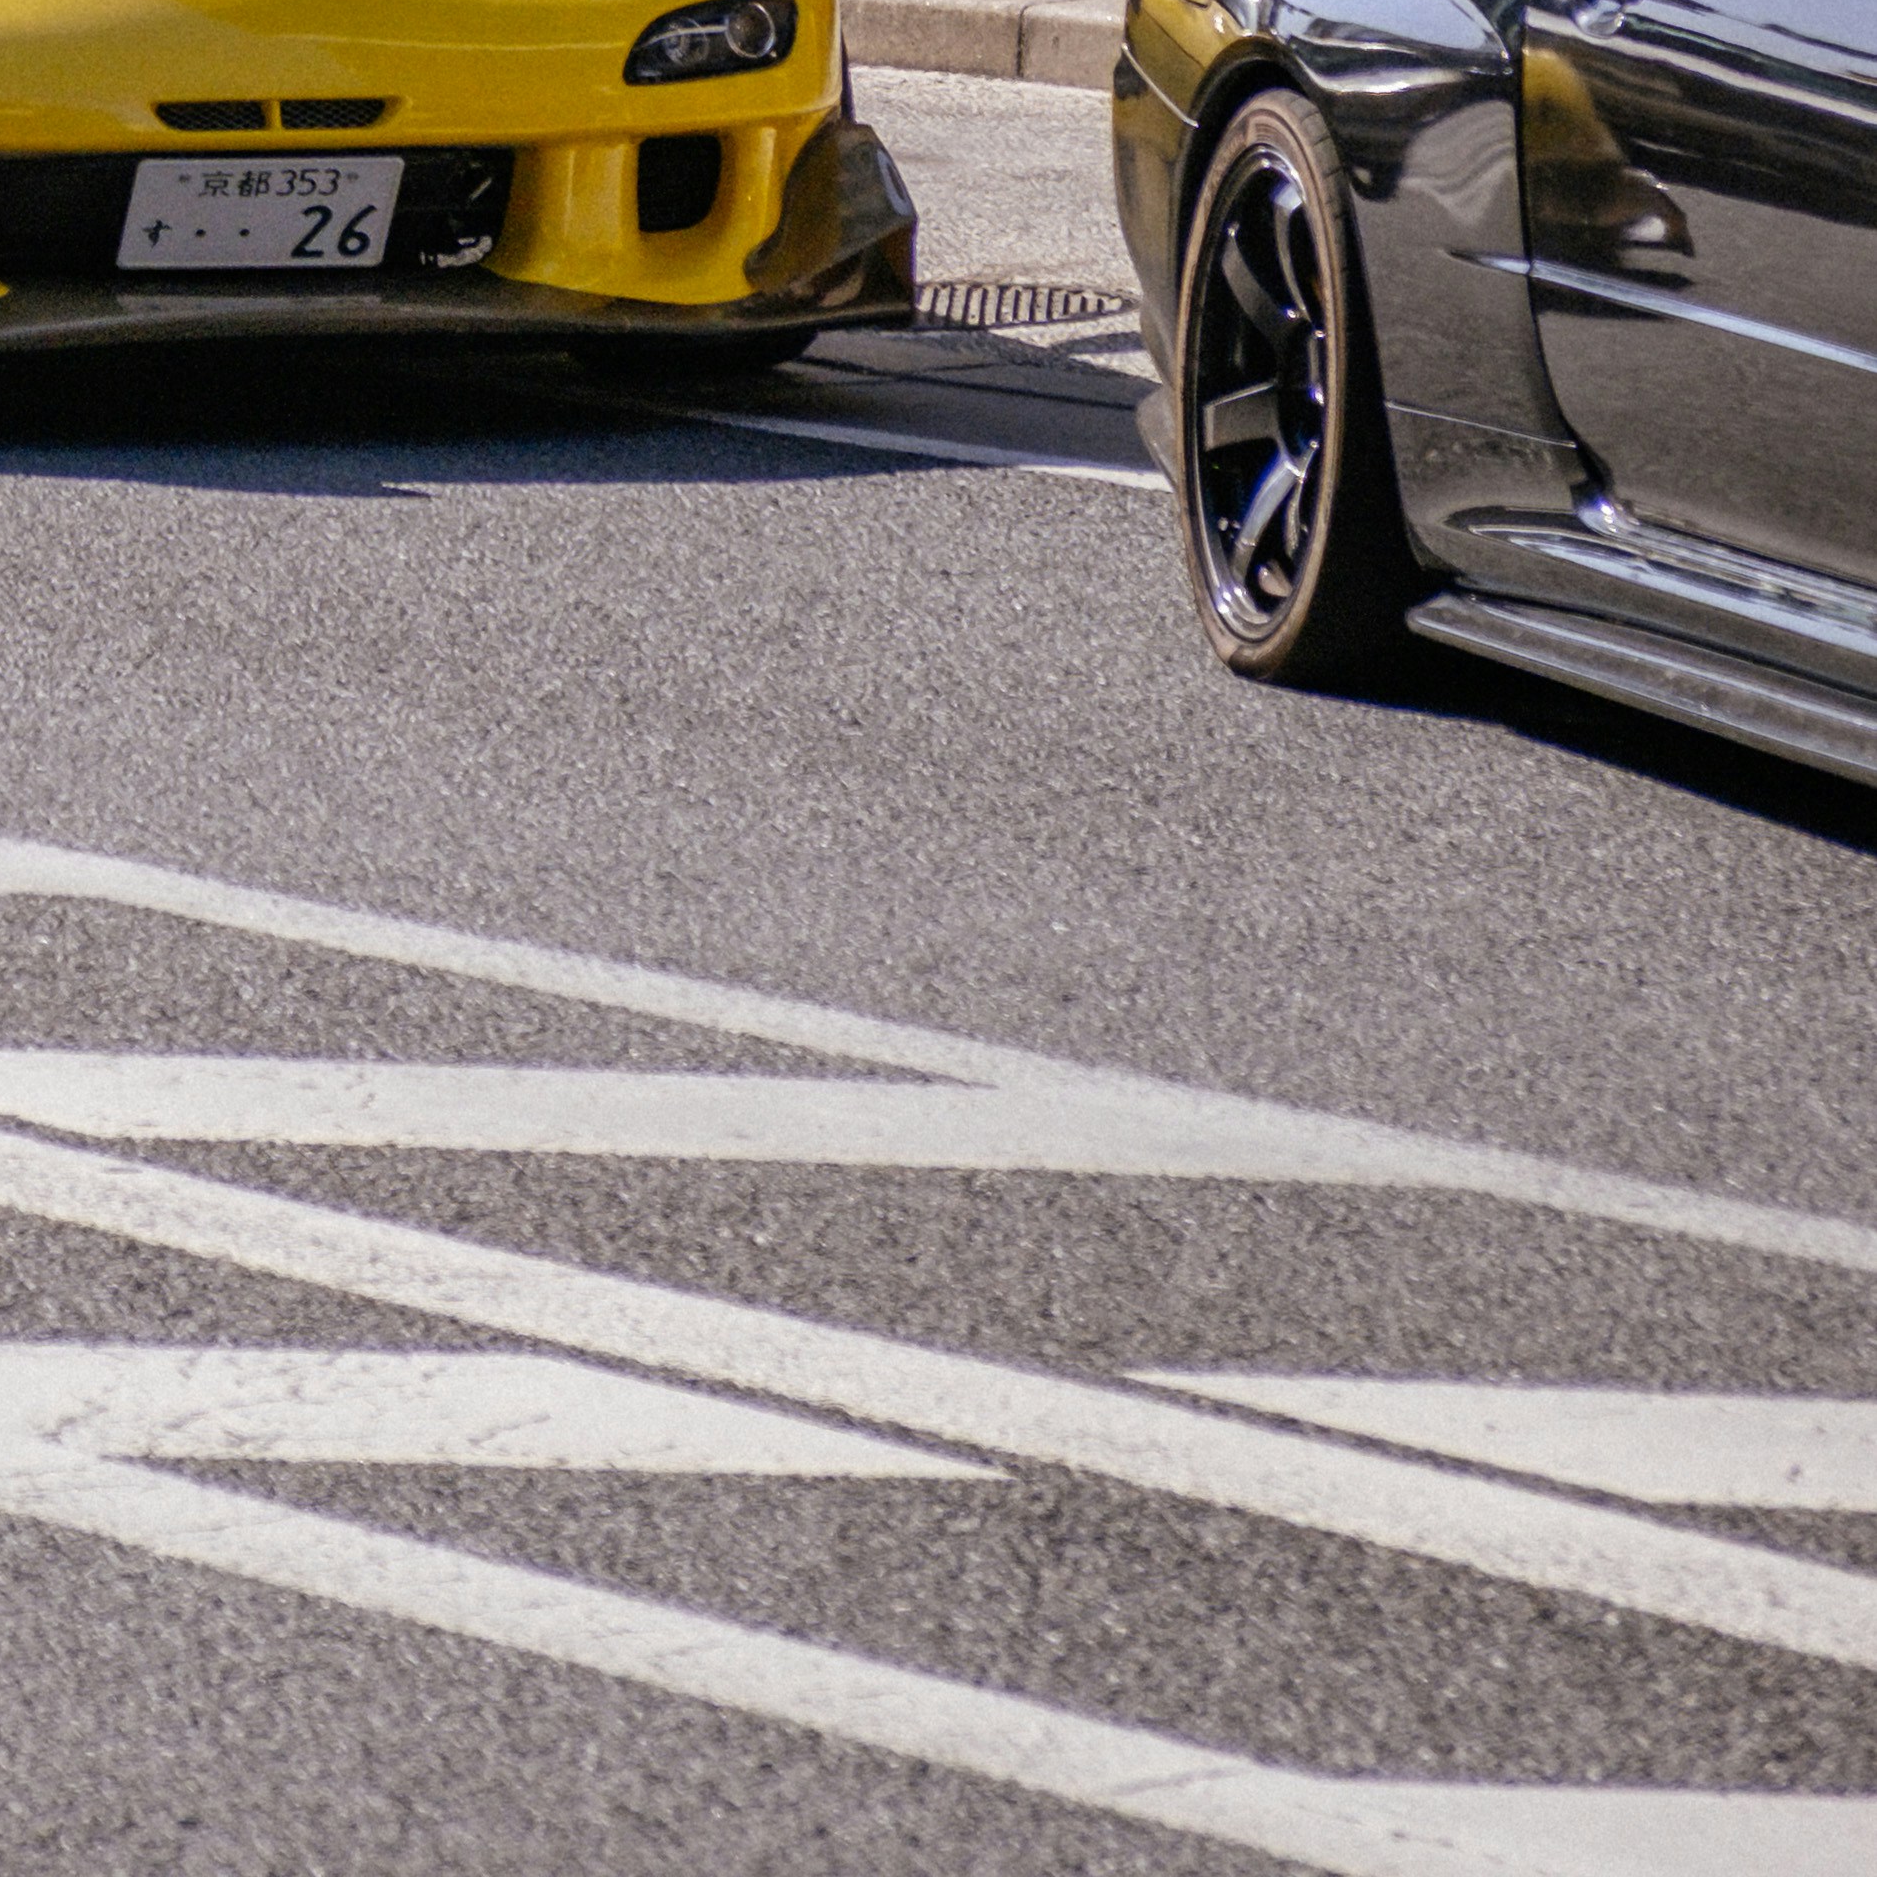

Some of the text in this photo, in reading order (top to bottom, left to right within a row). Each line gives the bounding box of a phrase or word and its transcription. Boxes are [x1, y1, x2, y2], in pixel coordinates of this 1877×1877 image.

[198, 167, 342, 197] 京都 353
[290, 204, 378, 260] 26
